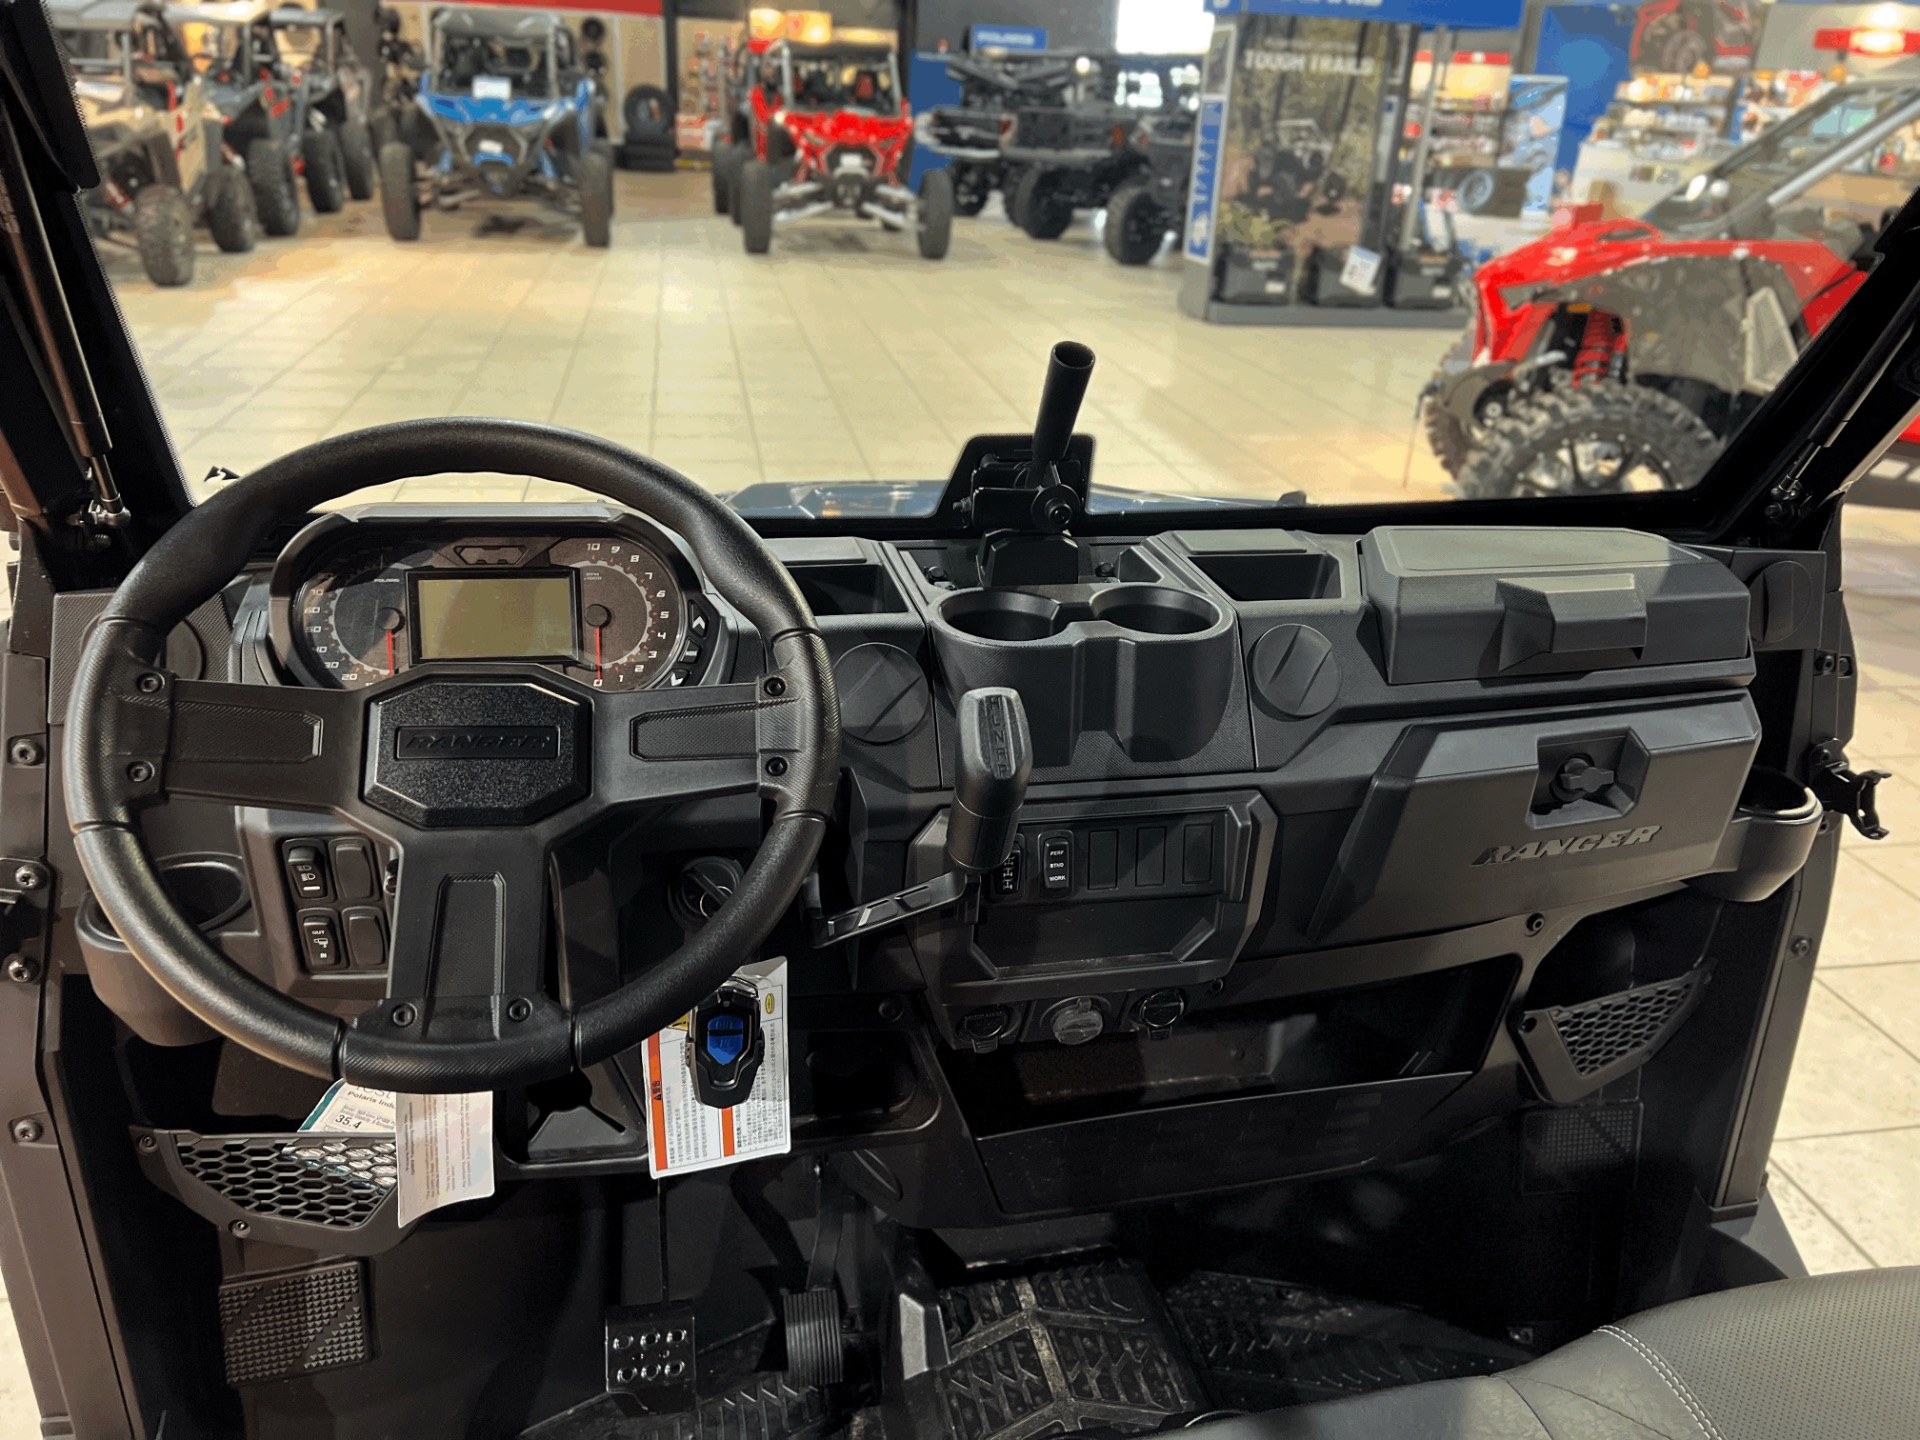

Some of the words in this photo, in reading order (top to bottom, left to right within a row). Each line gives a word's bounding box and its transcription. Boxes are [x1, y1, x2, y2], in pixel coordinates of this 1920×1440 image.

[1245, 49, 1304, 71] TOUGH
[587, 543, 600, 551] 10
[630, 555, 640, 563] 8
[645, 572, 653, 580] 7
[660, 611, 670, 619] 5
[657, 632, 667, 640] 4
[648, 651, 658, 659] 3
[634, 665, 645, 673] 2
[618, 674, 624, 683] 1
[1469, 825, 1663, 868] RANGER
[347, 1091, 377, 1103] Polaris
[335, 1114, 362, 1129] 35.4
